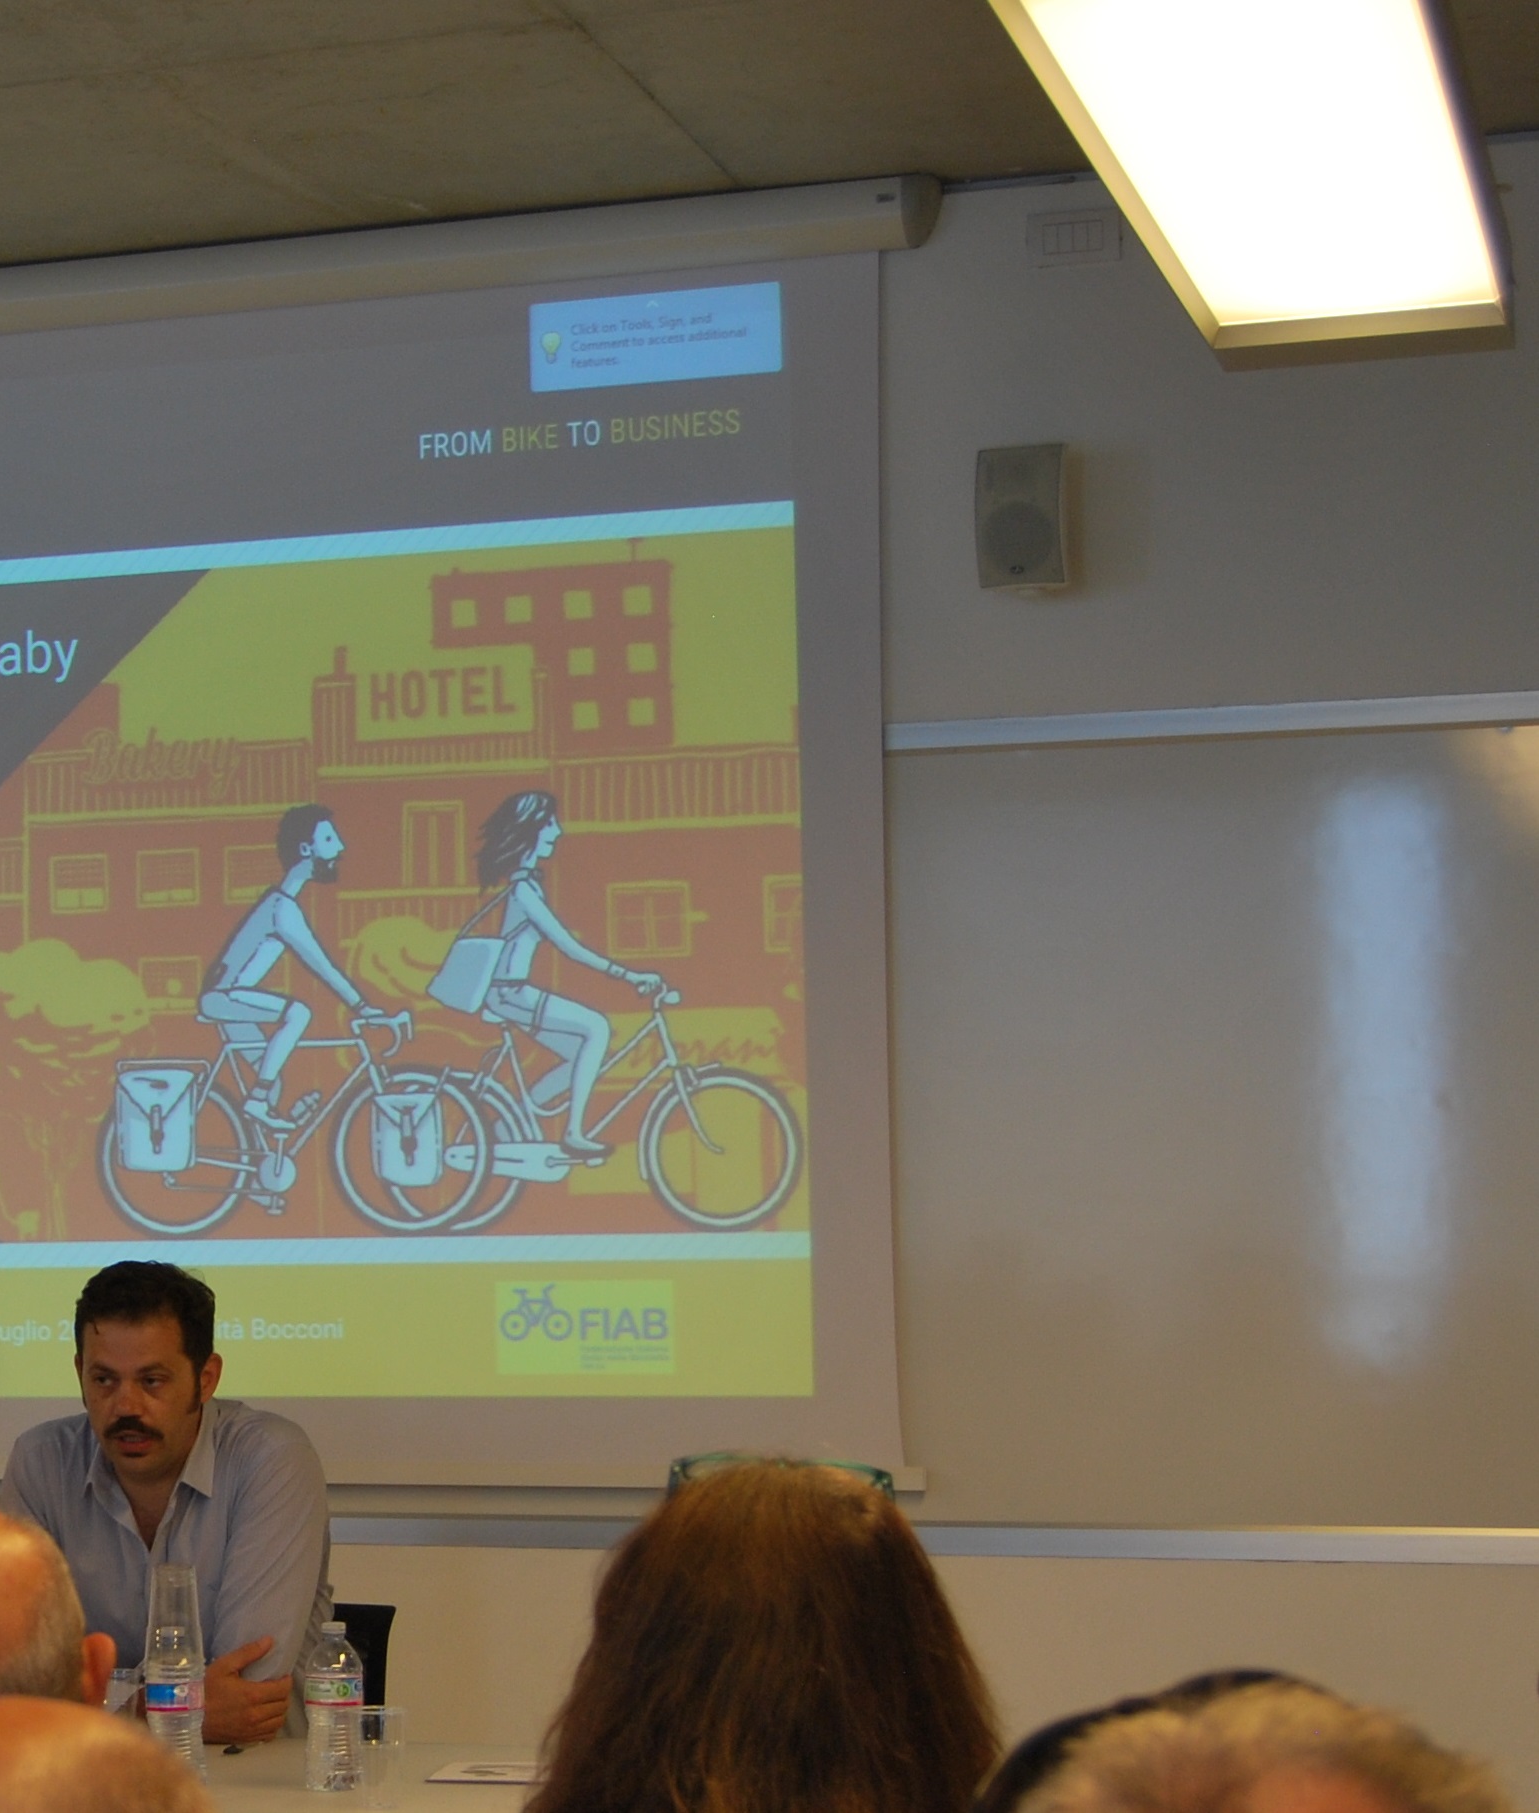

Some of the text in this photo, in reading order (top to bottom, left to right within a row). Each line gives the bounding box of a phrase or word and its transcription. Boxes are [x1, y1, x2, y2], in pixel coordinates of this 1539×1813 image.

[570, 324, 601, 336] Click
[602, 324, 618, 333] on
[690, 313, 712, 325] and
[570, 326, 748, 351] Comment to access additional
[419, 408, 741, 459] FROM BIKE TO BUSINESS
[369, 664, 517, 723] HOTEL
[81, 728, 240, 800] Bakery
[251, 1316, 345, 1341] Bocconi
[578, 1307, 669, 1341] FIAB
